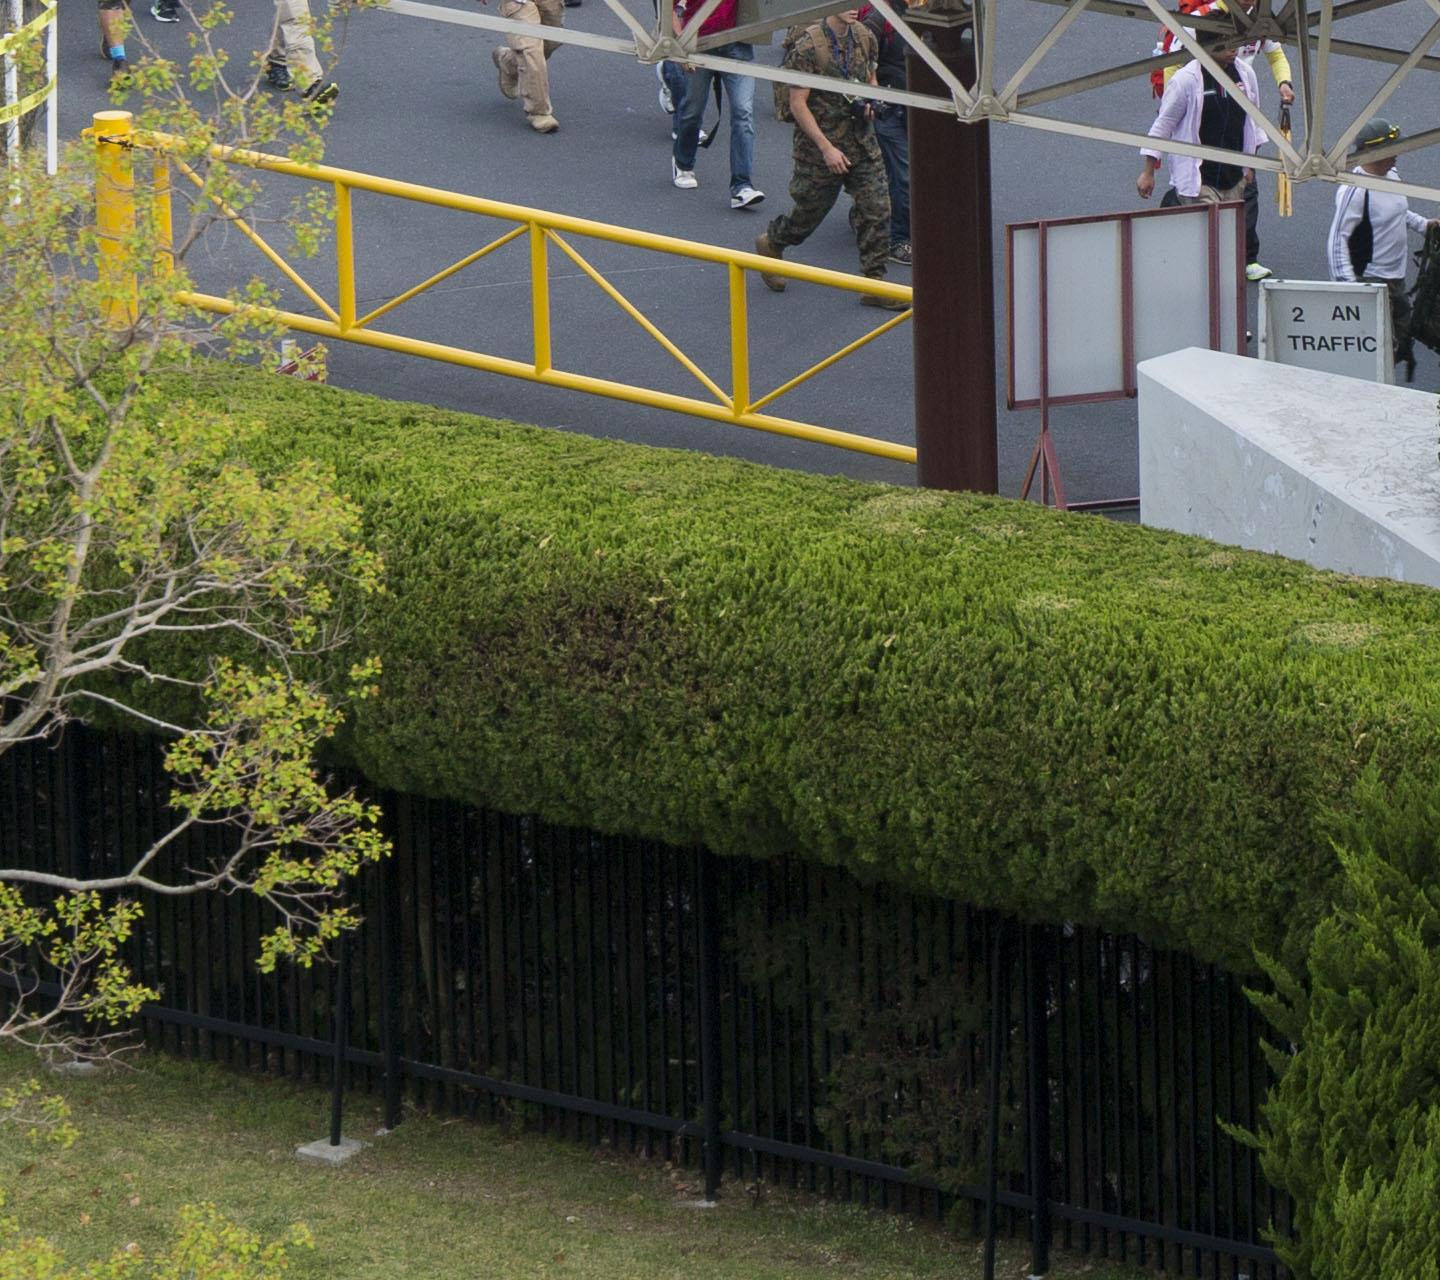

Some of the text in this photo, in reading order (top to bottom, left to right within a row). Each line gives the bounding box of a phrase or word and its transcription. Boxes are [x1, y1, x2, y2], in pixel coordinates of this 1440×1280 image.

[1292, 305, 1361, 322] 2 AN
[1288, 335, 1377, 353] TRAFFIC
